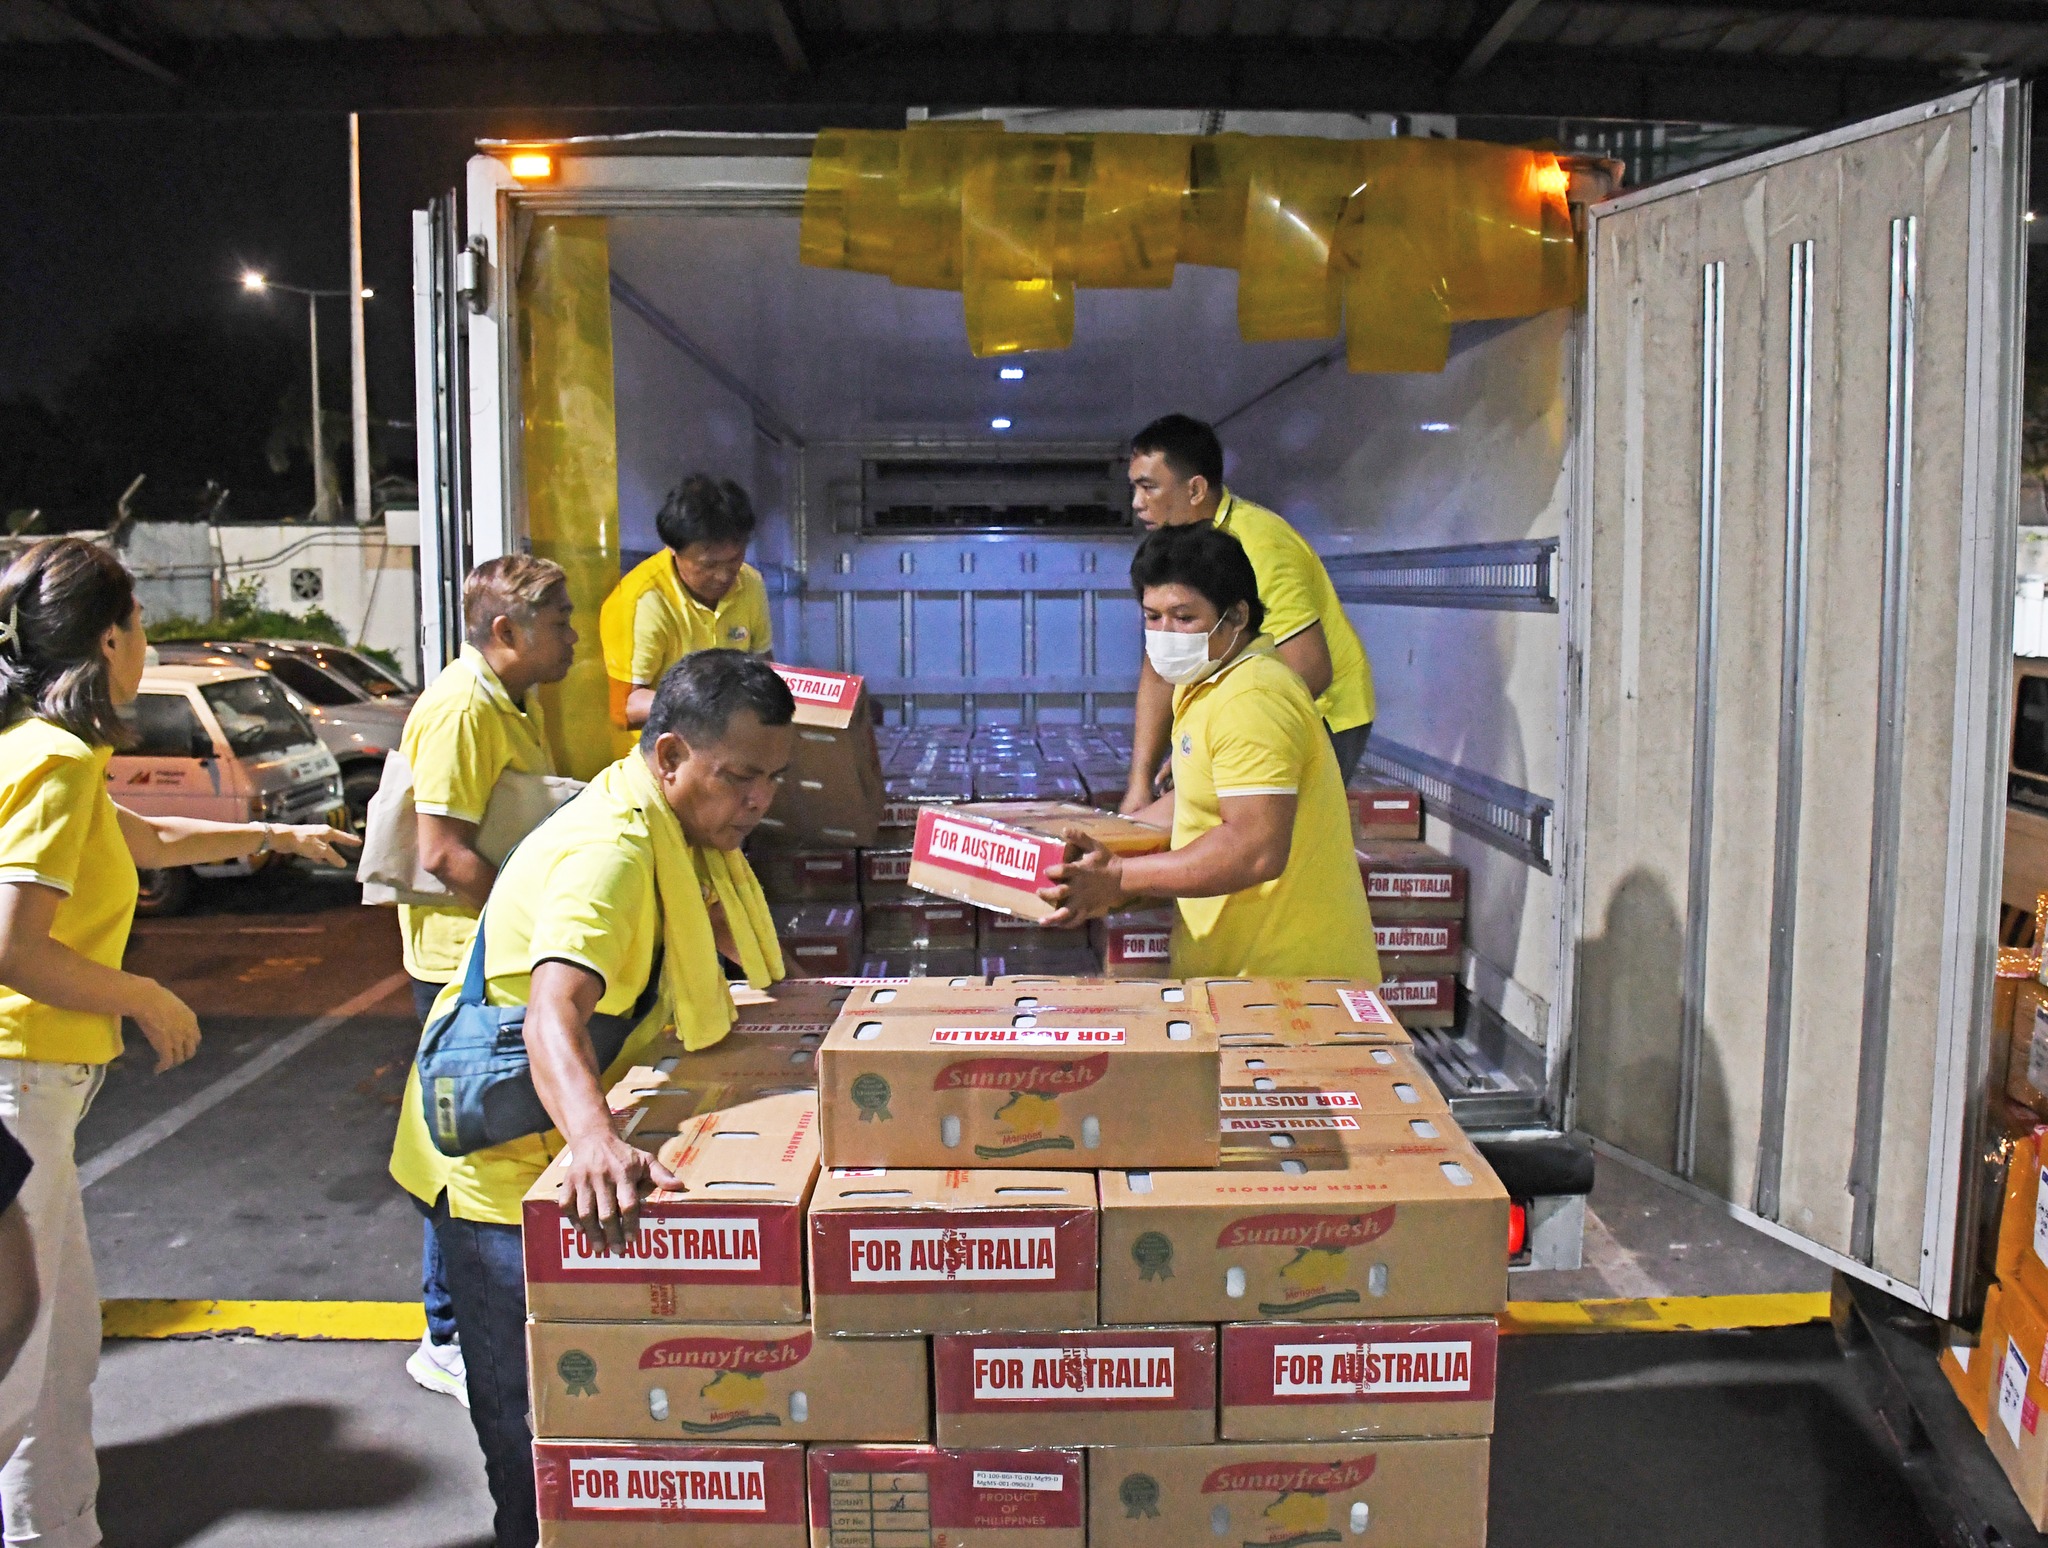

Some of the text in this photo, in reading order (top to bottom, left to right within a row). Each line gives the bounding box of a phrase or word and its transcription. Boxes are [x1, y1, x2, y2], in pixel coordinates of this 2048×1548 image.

[782, 676, 841, 698] STRALIA
[932, 828, 1037, 873] FOR AUSTRALIA
[1368, 877, 1451, 893] FOR AUSTRALIA
[1125, 938, 1145, 952] FOR
[1389, 932, 1447, 946] AUSTRALIA
[1379, 987, 1437, 1001] AUSTRALIA
[935, 1031, 1125, 1043] FOR AUSTRALIA
[948, 1063, 1095, 1091] Sunnyfresh
[1222, 1094, 1361, 1107] FOR AUSTRA
[1231, 1119, 1356, 1130] AUSTRALIA
[781, 1130, 804, 1163] MANGOES
[1216, 1183, 1388, 1193] FRESH MANGOES
[1230, 1217, 1381, 1247] Sunnyfresh
[851, 1239, 902, 1271] FOR
[910, 1237, 1054, 1270] AUSTRALIA
[652, 1343, 800, 1370] Sunnyfresh
[974, 1358, 1024, 1389] FOR
[1031, 1357, 1173, 1388] AUSTRALIA
[1274, 1354, 1323, 1385] FOR
[1330, 1351, 1470, 1383] AUSTRALIA
[571, 1468, 764, 1501] FOR AUSTRALIA
[1216, 1465, 1362, 1491] Sunnyfresh
[980, 1492, 1039, 1502] PRODUCT
[1001, 1504, 1019, 1514] OF
[974, 1516, 1046, 1526] PHILIPPINES
